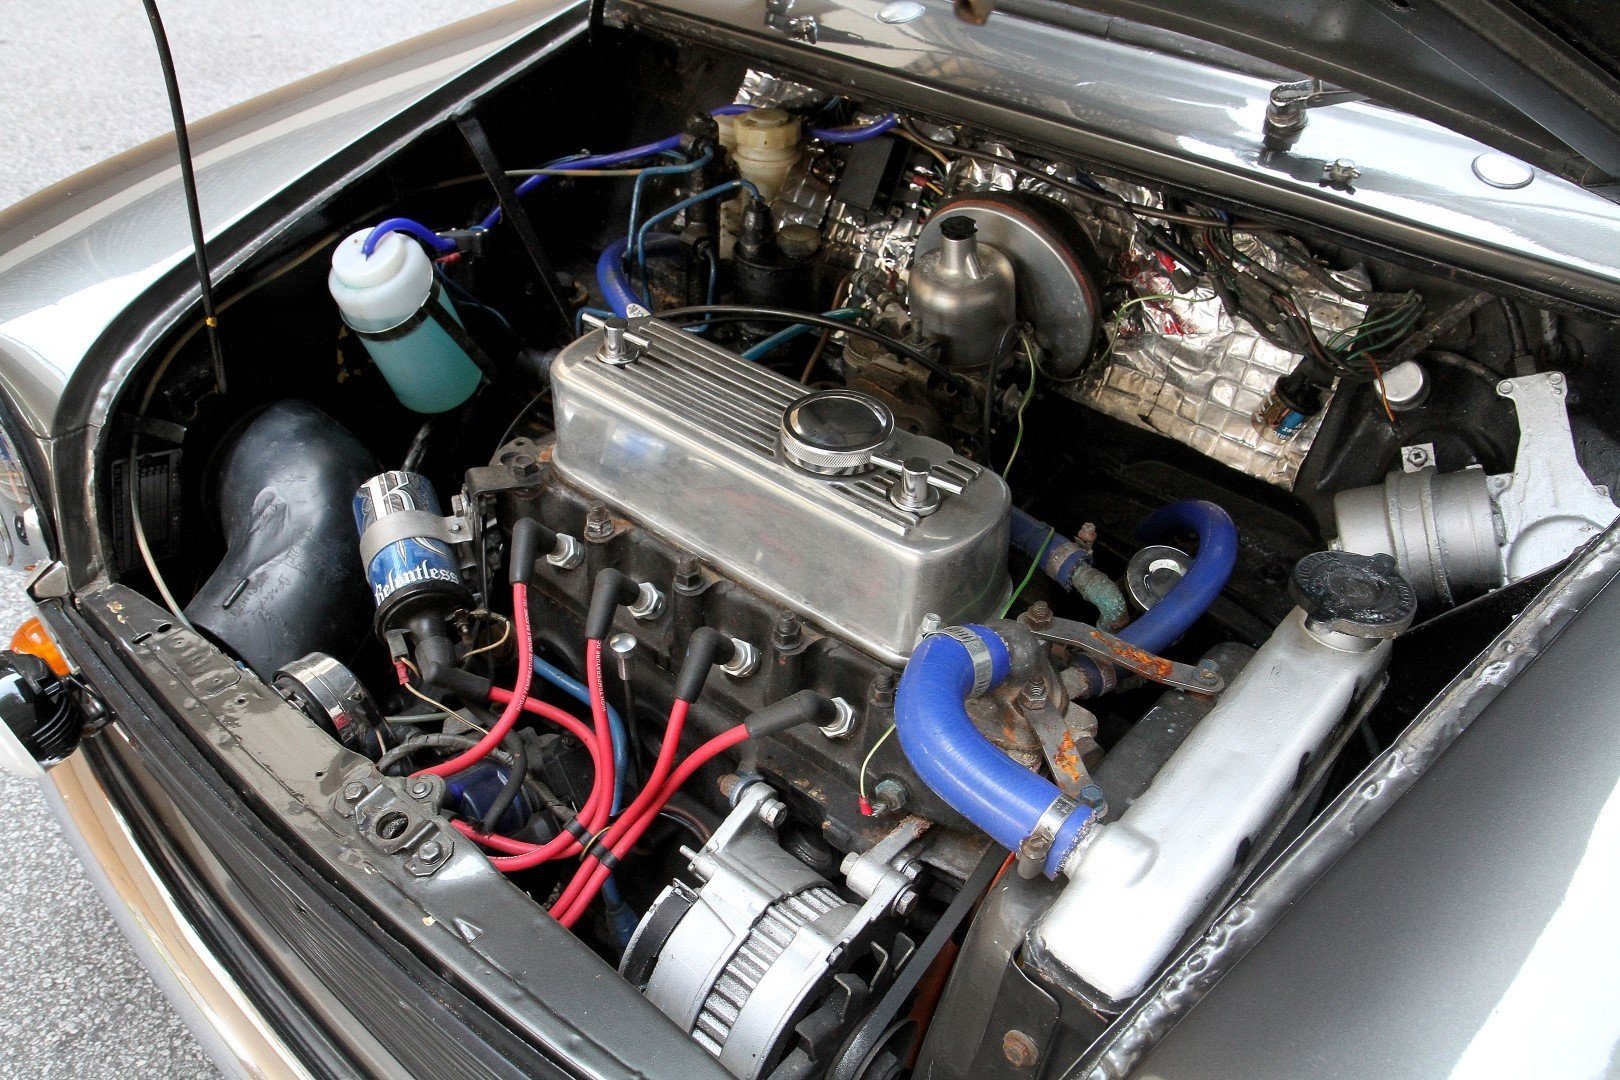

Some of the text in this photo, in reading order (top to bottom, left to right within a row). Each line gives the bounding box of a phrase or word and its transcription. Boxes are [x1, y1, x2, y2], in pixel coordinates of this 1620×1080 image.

[374, 560, 459, 606] Relentless
[516, 694, 527, 712] HIGH
[523, 652, 534, 694] TEMPERATURE
[595, 650, 604, 696] TEMPERATURE
